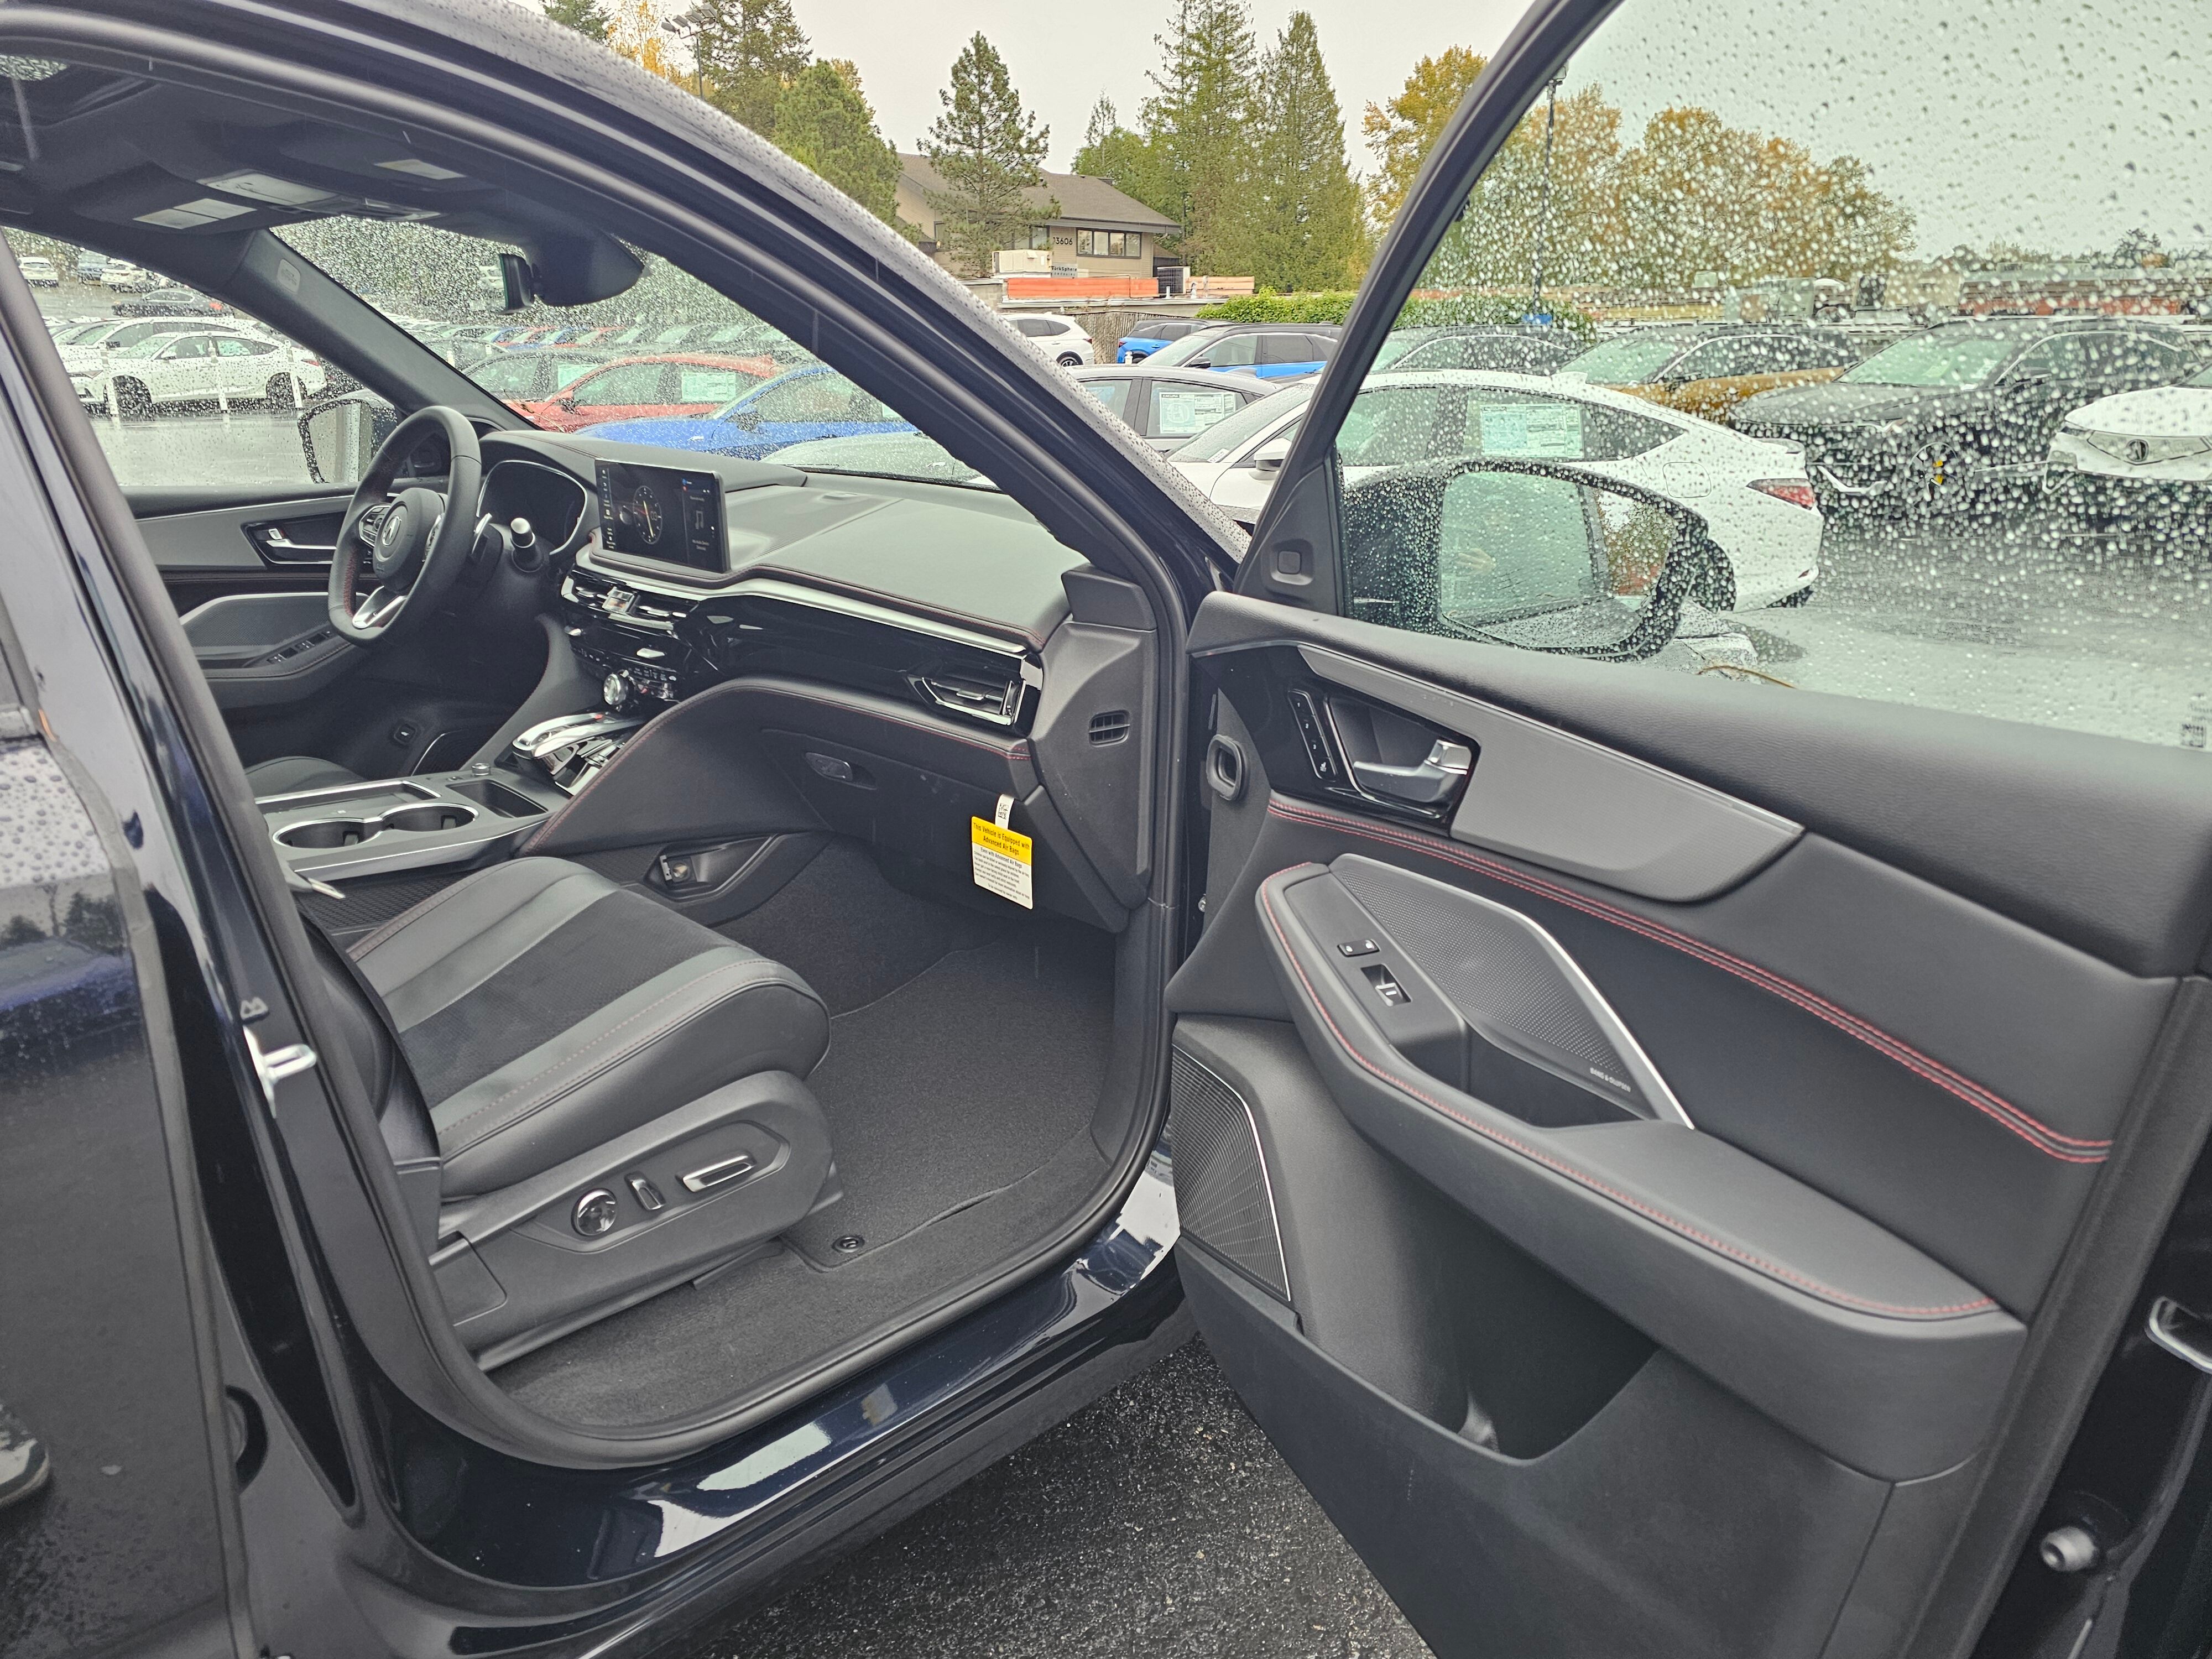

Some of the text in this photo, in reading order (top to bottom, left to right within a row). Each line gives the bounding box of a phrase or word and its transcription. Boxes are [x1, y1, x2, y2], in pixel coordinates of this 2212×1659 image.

[982, 826, 997, 837] Vehicle
[1002, 833, 1020, 846] Equipped
[983, 836, 1001, 848] Advanced
[1009, 846, 1019, 855] Bags
